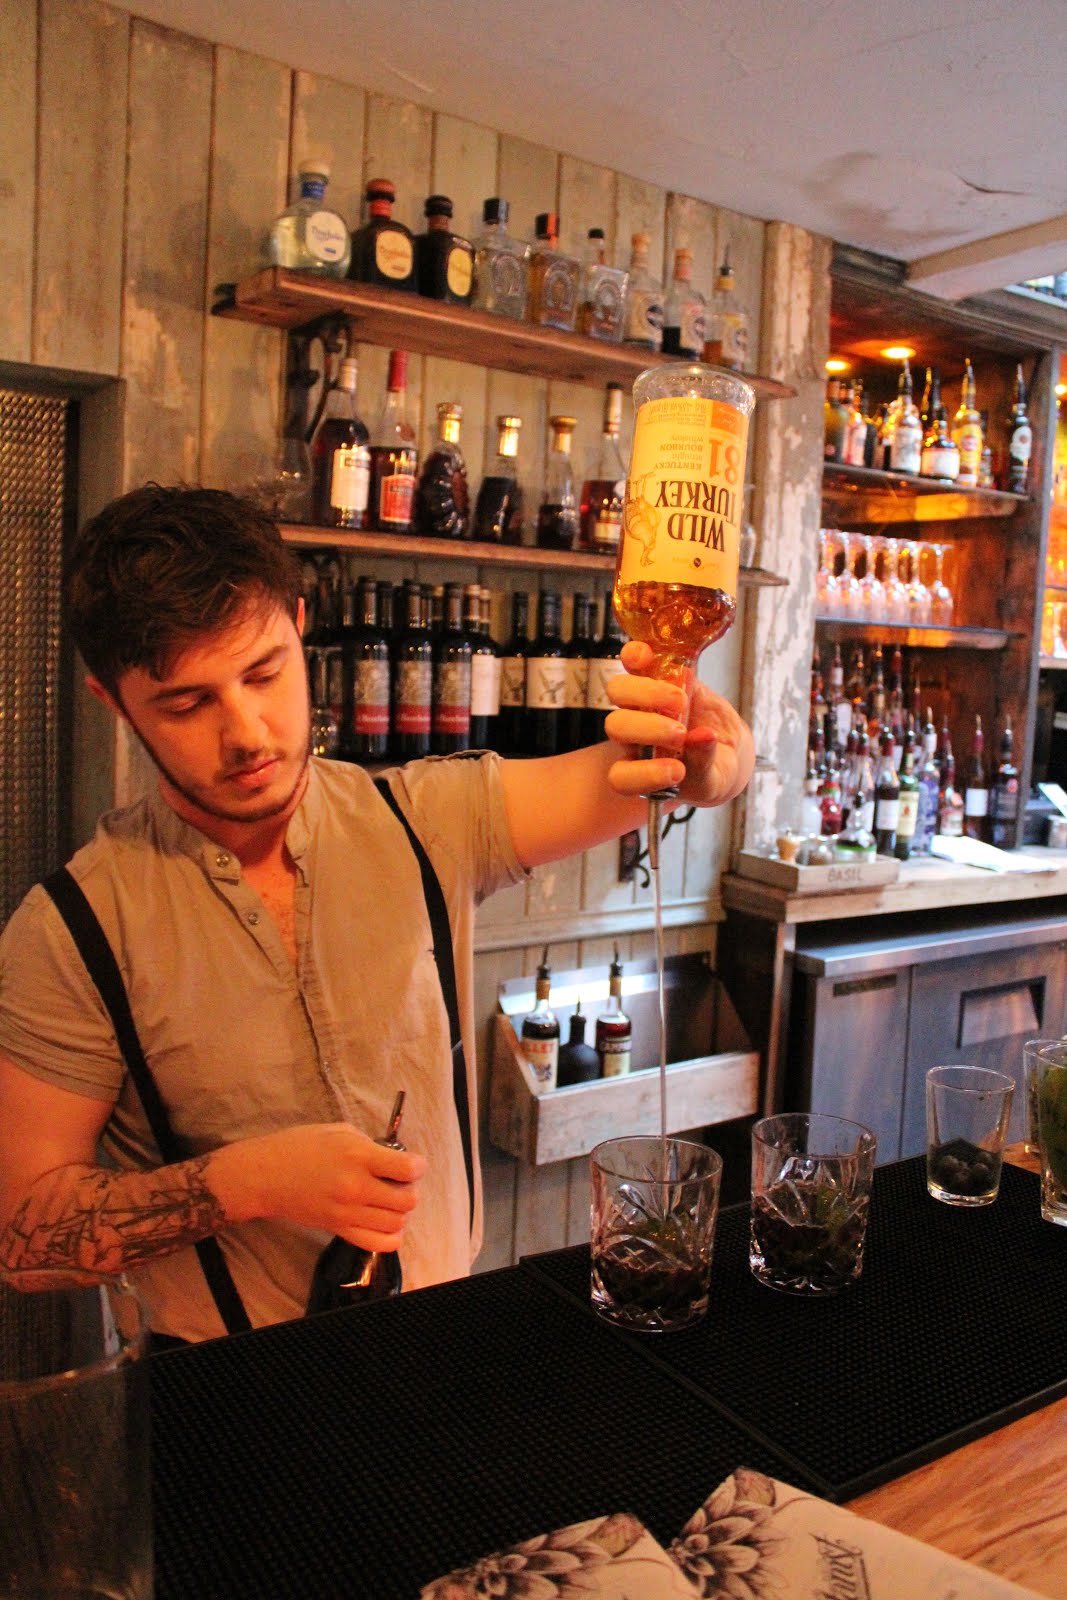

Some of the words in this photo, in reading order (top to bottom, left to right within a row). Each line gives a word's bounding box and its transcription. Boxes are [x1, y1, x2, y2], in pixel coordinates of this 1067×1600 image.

[660, 443, 704, 452] BOURBON
[709, 437, 741, 485] 81
[654, 461, 702, 471] KENTUCKY
[654, 480, 737, 528] TURKEY
[667, 512, 725, 552] WILD
[828, 867, 865, 882] BASIL
